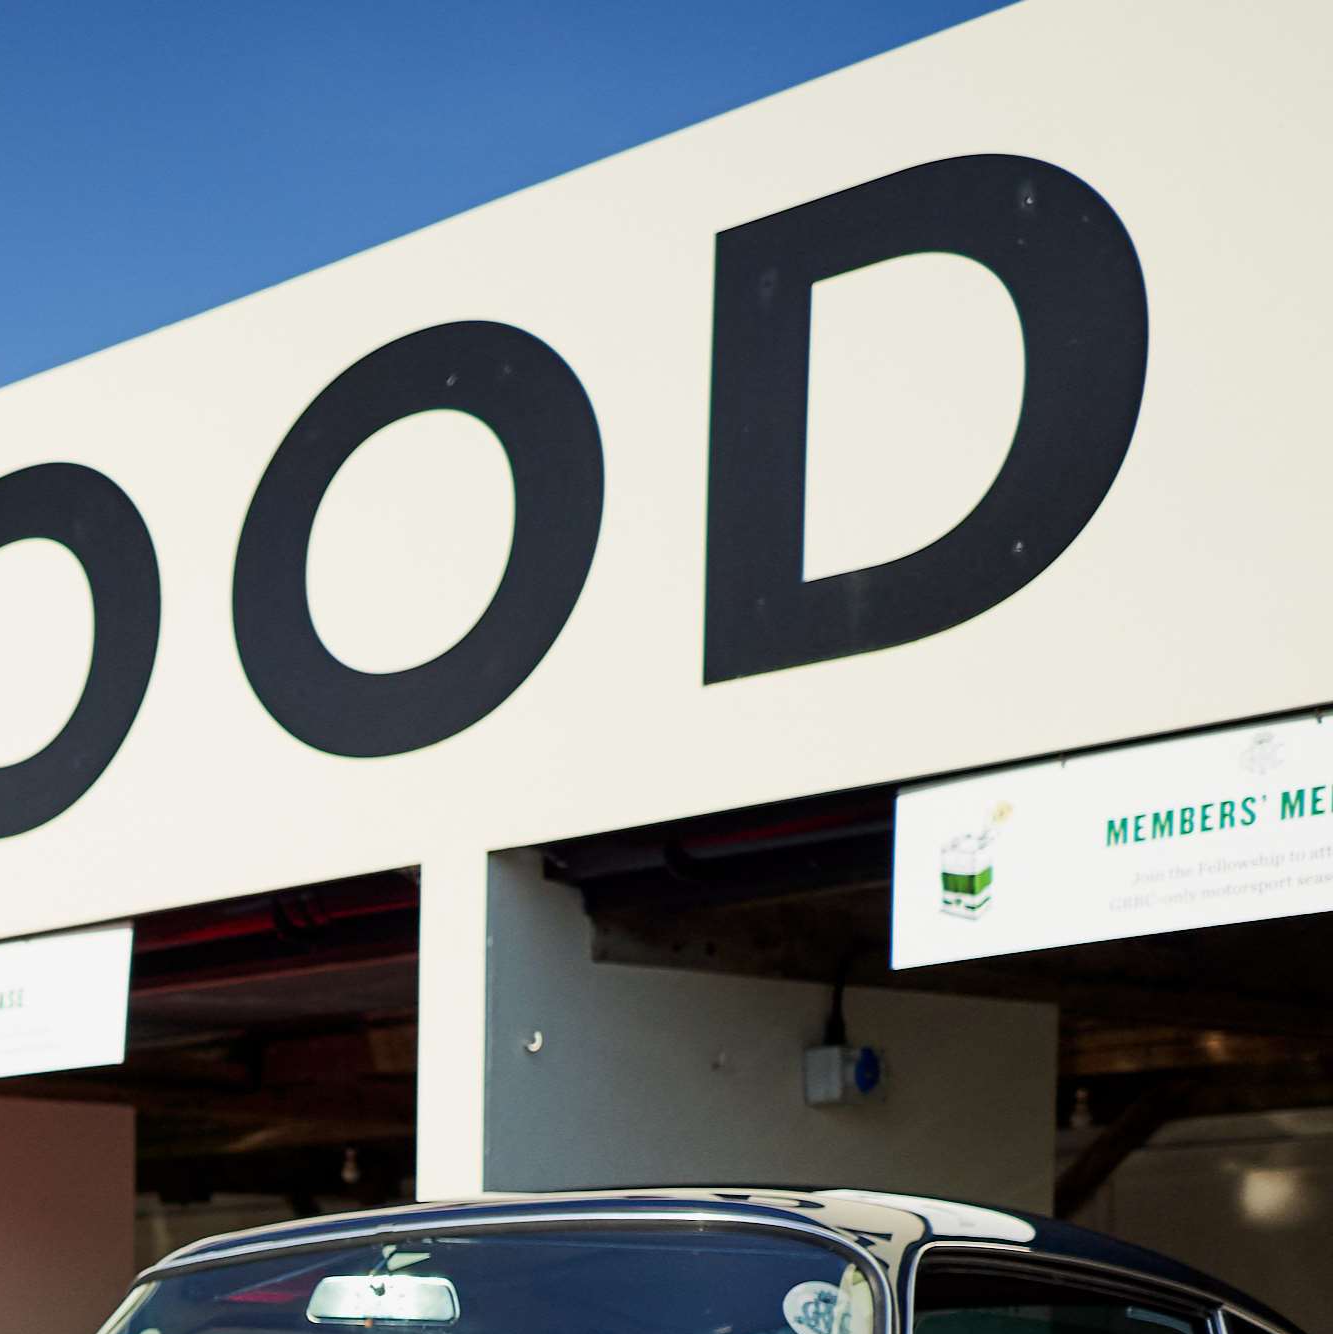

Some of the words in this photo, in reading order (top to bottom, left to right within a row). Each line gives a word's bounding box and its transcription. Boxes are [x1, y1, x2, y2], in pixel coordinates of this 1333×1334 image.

[1105, 794, 1268, 848] MEMBERS'
[1280, 784, 1333, 821] ME
[1198, 850, 1282, 877] Fellowship
[1201, 876, 1293, 896] motorsport
